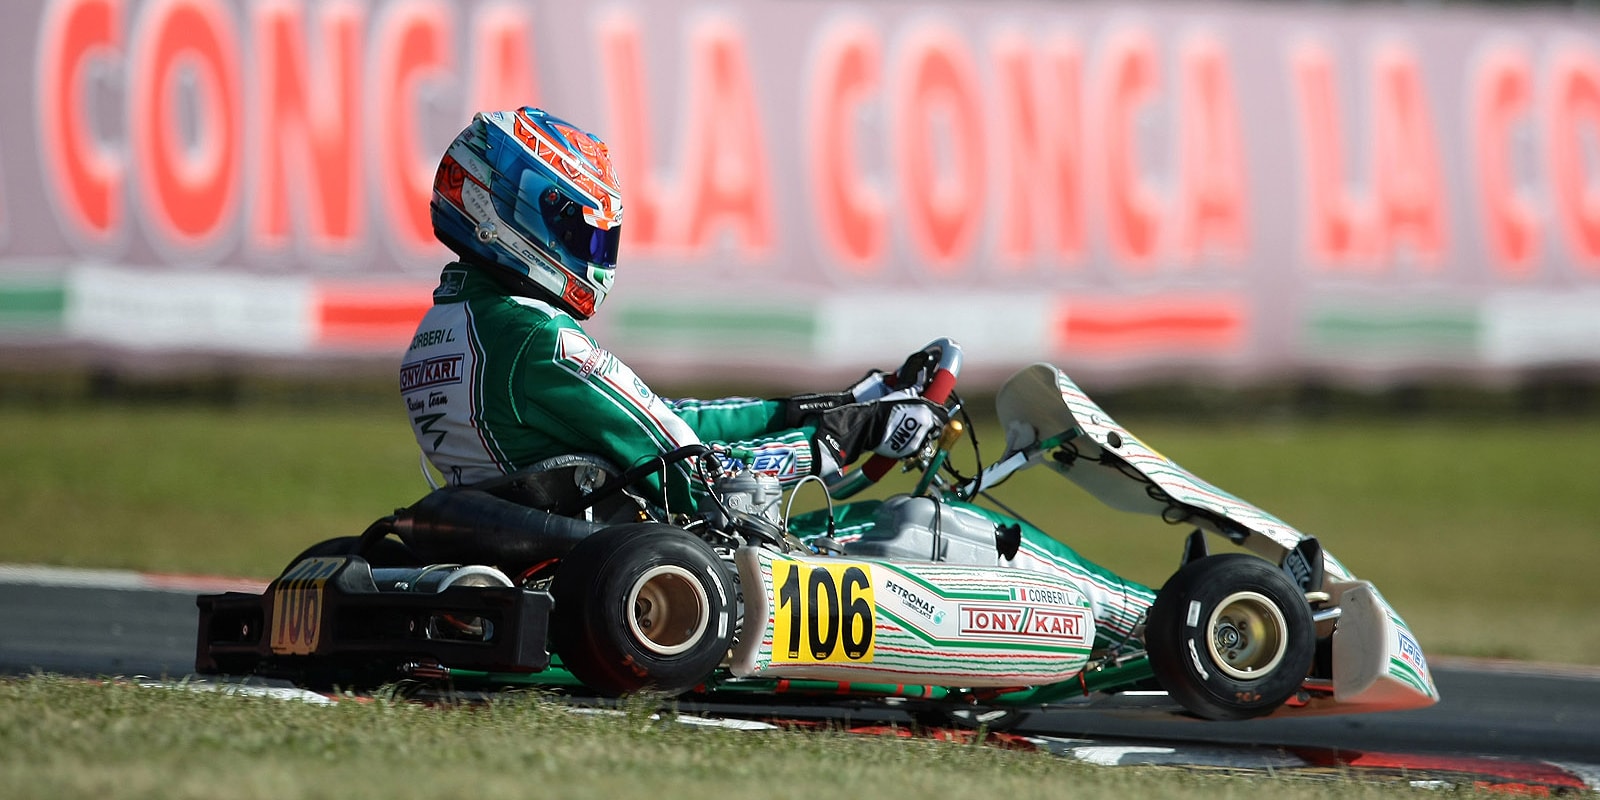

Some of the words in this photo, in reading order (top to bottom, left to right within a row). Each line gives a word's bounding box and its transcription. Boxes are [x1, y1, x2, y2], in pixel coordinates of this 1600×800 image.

[590, 8, 770, 258] LA
[806, 22, 1250, 270] CONCA
[1288, 34, 1450, 272] LA
[400, 364, 421, 388] ONY
[425, 357, 462, 382] KART
[890, 417, 918, 451] OMP
[278, 560, 338, 646] 106
[779, 564, 873, 660] 106
[885, 580, 935, 614] PETRONAS
[1029, 588, 1067, 605] CORBERI
[961, 607, 1021, 631] TONY
[1034, 611, 1084, 635] KART
